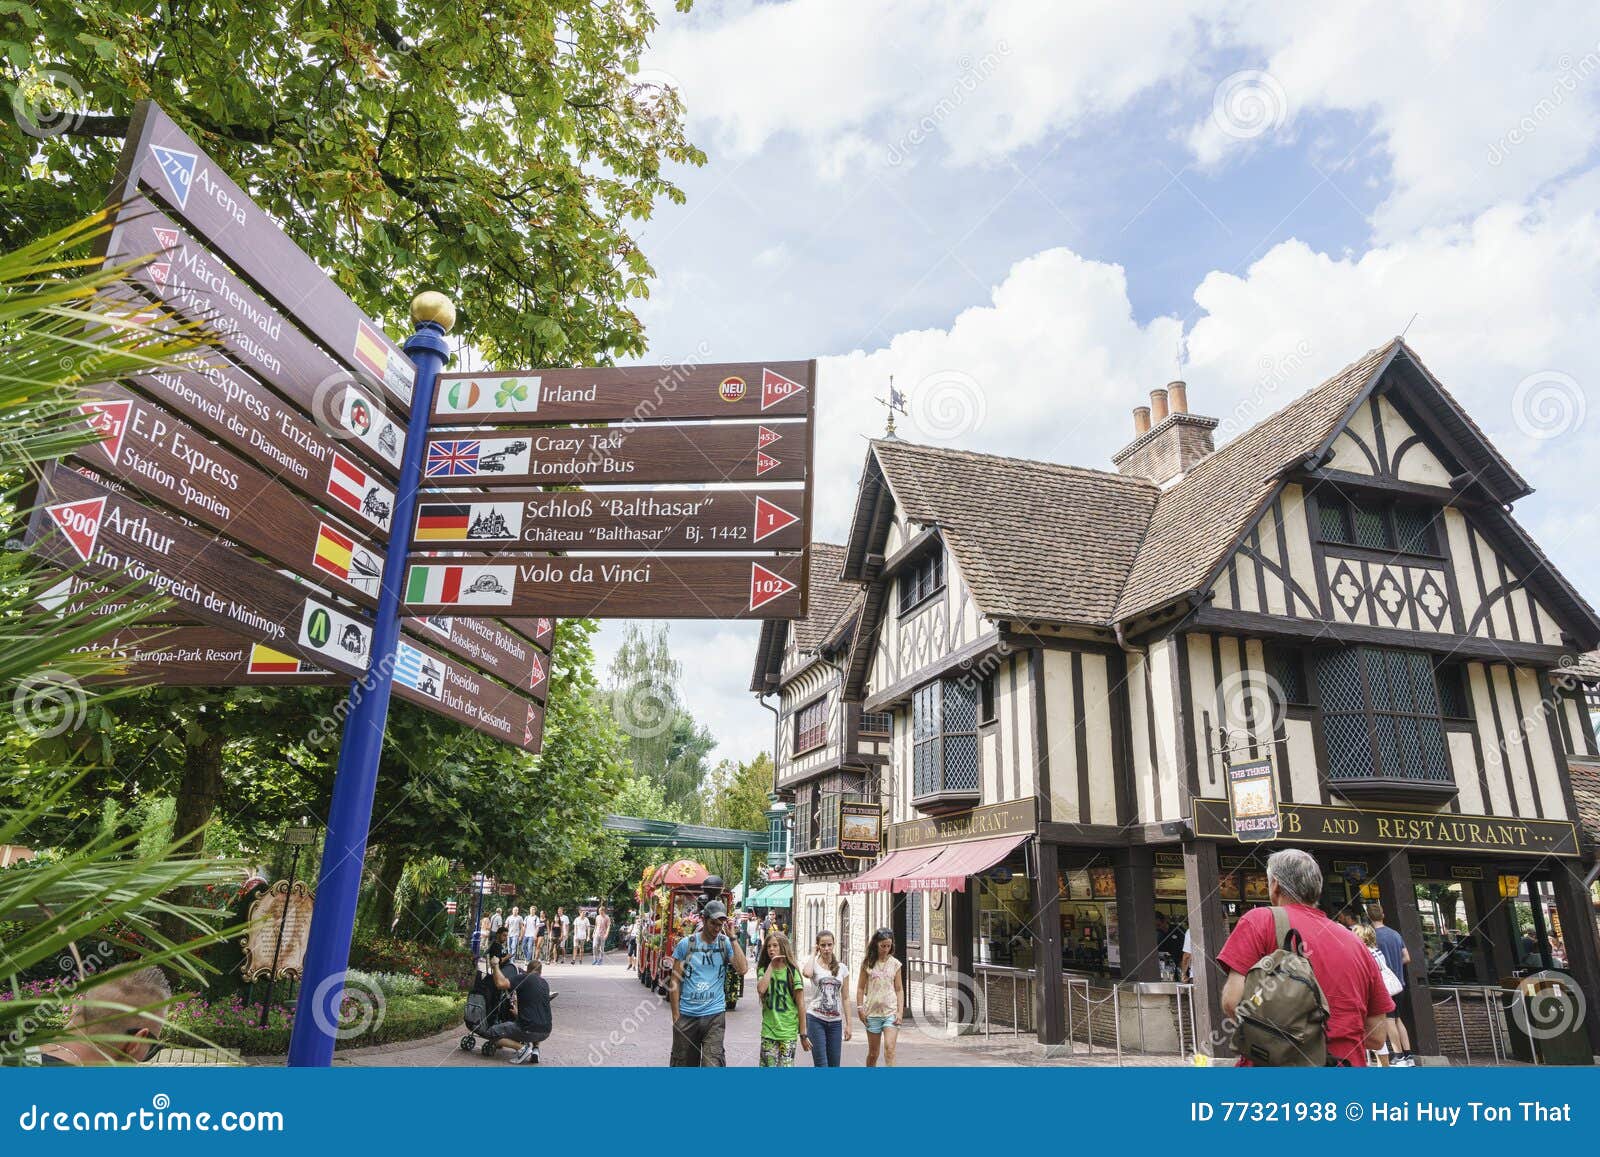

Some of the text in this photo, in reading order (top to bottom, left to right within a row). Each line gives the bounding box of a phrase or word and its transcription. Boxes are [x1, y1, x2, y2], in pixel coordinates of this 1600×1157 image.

[162, 152, 247, 227] 770 Arena
[149, 265, 167, 283] 602
[158, 231, 176, 247] 610
[178, 245, 282, 342] Märchenwald
[542, 382, 792, 403] Irland NEU 160
[131, 407, 167, 448] E.P.
[171, 432, 240, 491] Express
[227, 415, 249, 438] der
[249, 428, 309, 480] Diamanten
[535, 436, 583, 456] Crazy
[590, 434, 624, 449] Taxi
[532, 458, 598, 475] London
[603, 457, 635, 473] Bus
[122, 447, 175, 490] Station
[178, 478, 231, 520] Spanien
[526, 497, 775, 526] Schloß “Balthasar” 1
[60, 507, 97, 537] 900
[103, 506, 175, 555] Arthur
[523, 524, 747, 543] Château “Balthasar” Bj. 1442
[95, 545, 119, 570] Im
[123, 556, 201, 604] Königreich
[203, 593, 226, 614] der
[227, 600, 287, 640] Minimoys
[519, 563, 783, 593] Volo da Vinci 102
[133, 648, 202, 666] Europa-Park
[205, 648, 243, 662] Resort
[451, 631, 480, 658] Bobsleigh
[495, 631, 526, 662] Bobbahn
[446, 666, 480, 695] Poseidon
[442, 689, 511, 734] Fluch der Kassandra
[1230, 766, 1271, 779] THE THREE
[941, 811, 1009, 839] RESTAURANT
[1233, 814, 1279, 832] PIGLETS
[1322, 818, 1360, 835] AND
[1378, 817, 1528, 847] RESTAURANT
[841, 840, 881, 851] PIGLETS
